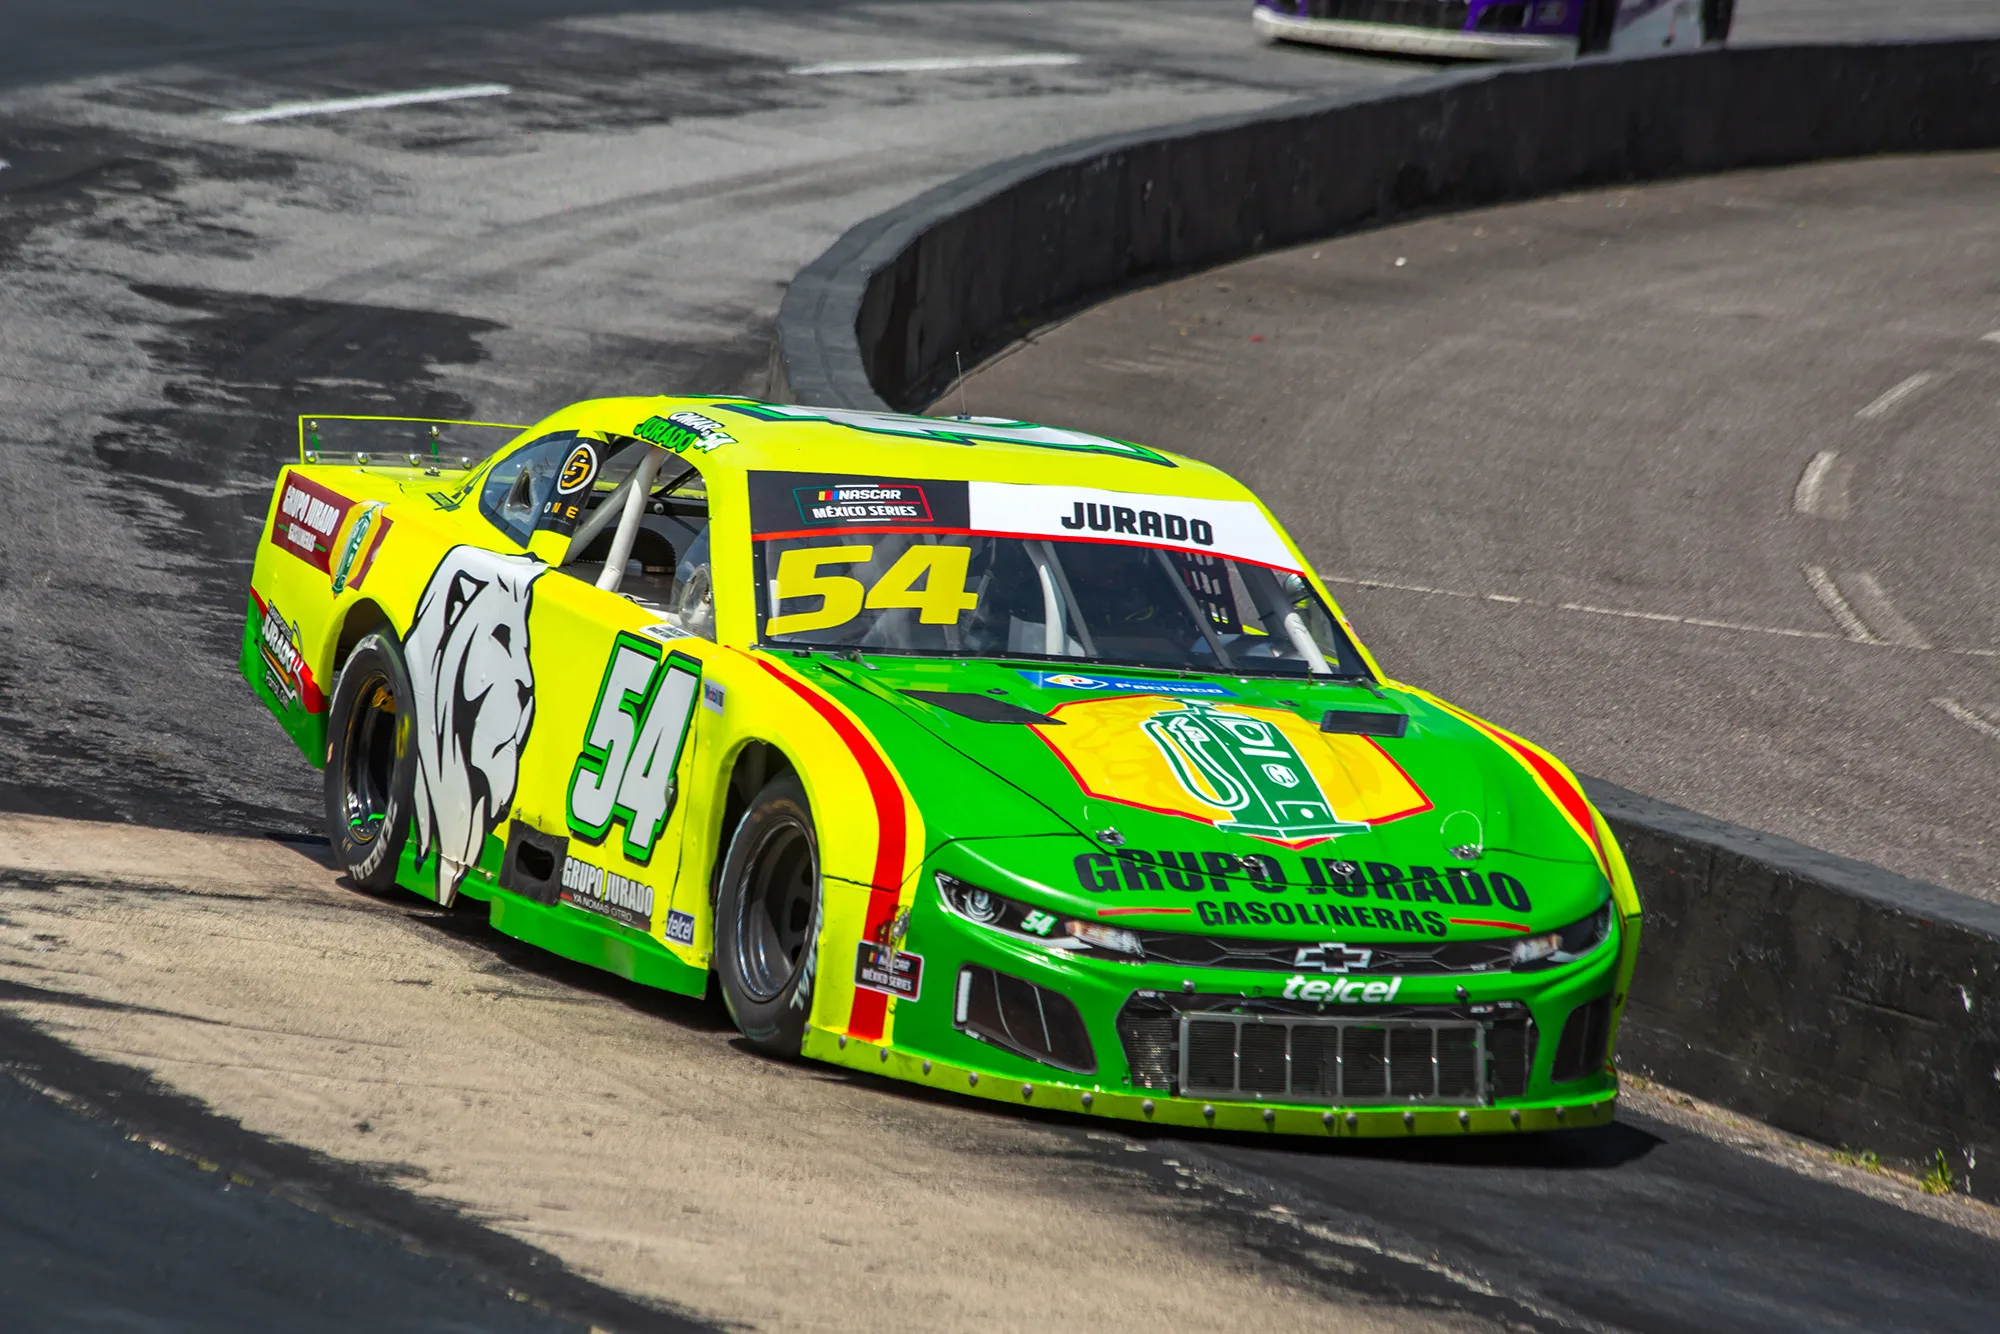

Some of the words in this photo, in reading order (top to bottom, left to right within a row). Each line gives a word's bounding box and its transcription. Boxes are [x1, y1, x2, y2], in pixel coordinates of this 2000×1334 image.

[631, 415, 697, 453] JURADO
[812, 505, 866, 519] MÉXICO
[867, 506, 918, 517] SERIES
[838, 490, 901, 500] NASCAR
[1061, 501, 1214, 546] JURADO
[765, 545, 979, 637] 54
[569, 638, 701, 857] 54
[561, 856, 604, 899] GRUPO
[604, 870, 655, 917] JURADO
[1073, 848, 1288, 894] GRUPO
[1305, 857, 1531, 913] JURADO
[666, 913, 694, 942] telcel
[1021, 909, 1057, 936] 54
[1197, 900, 1447, 938] GASOLINERAS
[1283, 975, 1402, 1003] telcel
